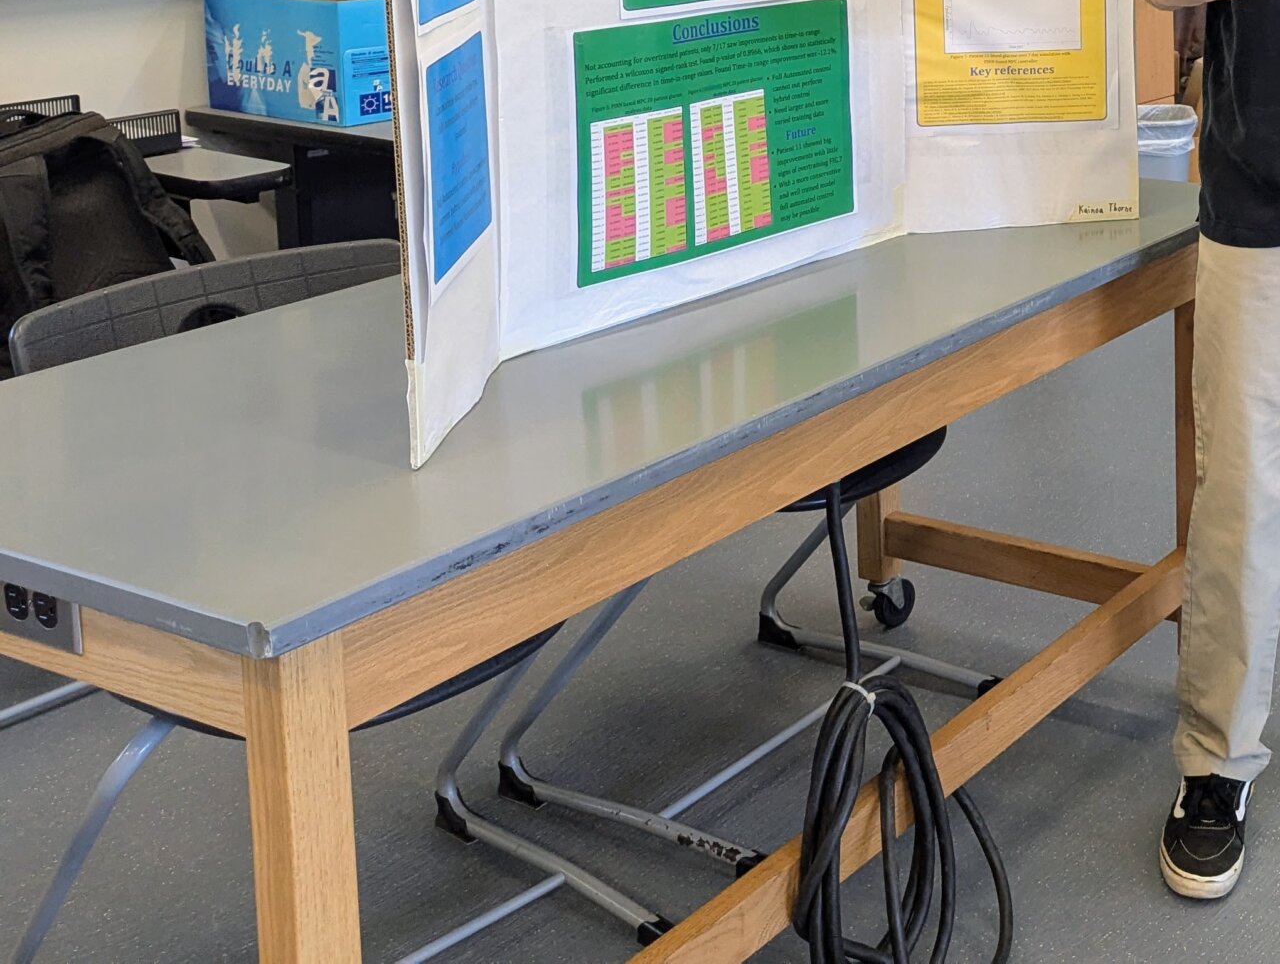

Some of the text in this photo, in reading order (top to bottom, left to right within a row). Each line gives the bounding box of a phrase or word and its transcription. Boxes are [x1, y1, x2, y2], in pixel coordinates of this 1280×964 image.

[672, 15, 760, 42] Conclusions
[970, 64, 1055, 78] Key references
[227, 72, 292, 93] EVERYDAY
[785, 126, 816, 141] Future
